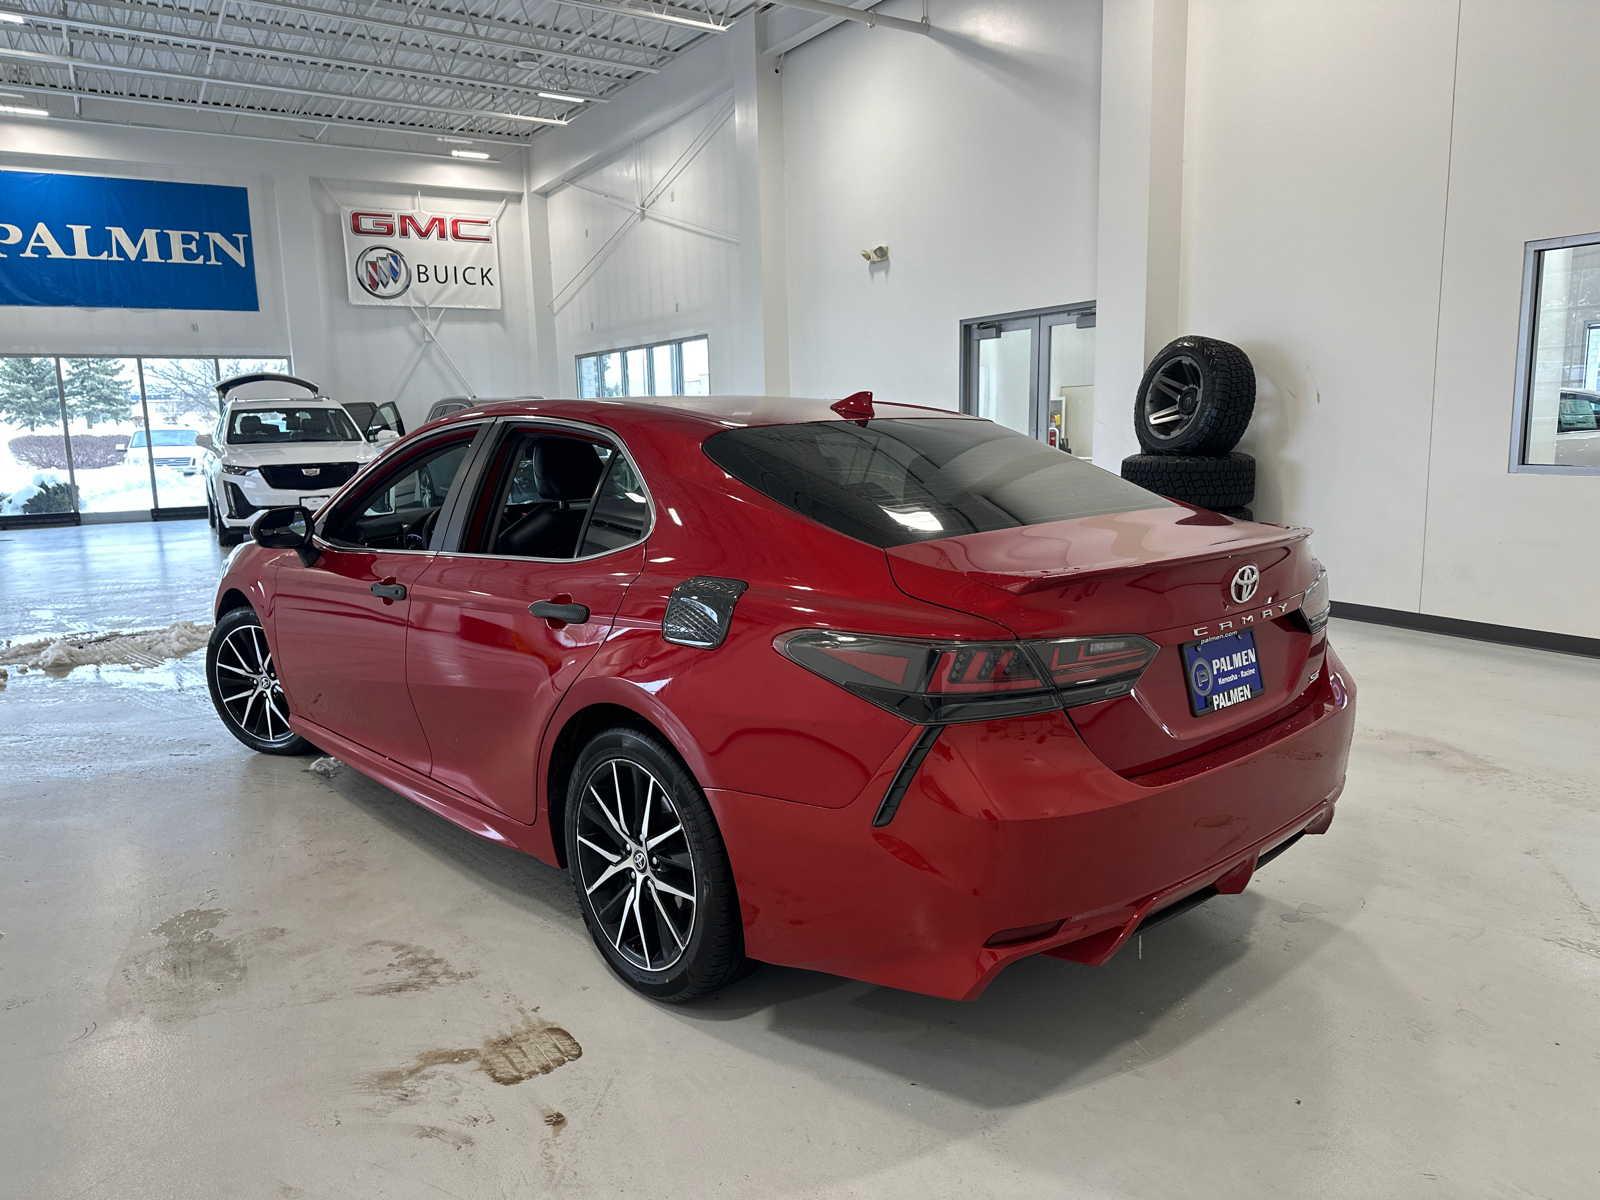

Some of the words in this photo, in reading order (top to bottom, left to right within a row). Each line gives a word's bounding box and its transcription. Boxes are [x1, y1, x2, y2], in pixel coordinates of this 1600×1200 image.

[349, 209, 493, 244] GMC
[0, 222, 248, 268] PALMEN
[416, 263, 494, 286] BUICK
[1194, 603, 1288, 636] CAMRY
[1200, 630, 1237, 645] palmen.com
[1212, 647, 1256, 675] PALMEN
[1197, 670, 1209, 687] P
[1218, 674, 1238, 685] Kenosha
[1240, 668, 1255, 678] Racine
[1309, 669, 1320, 684] SE
[1212, 683, 1252, 711] PALMEN
